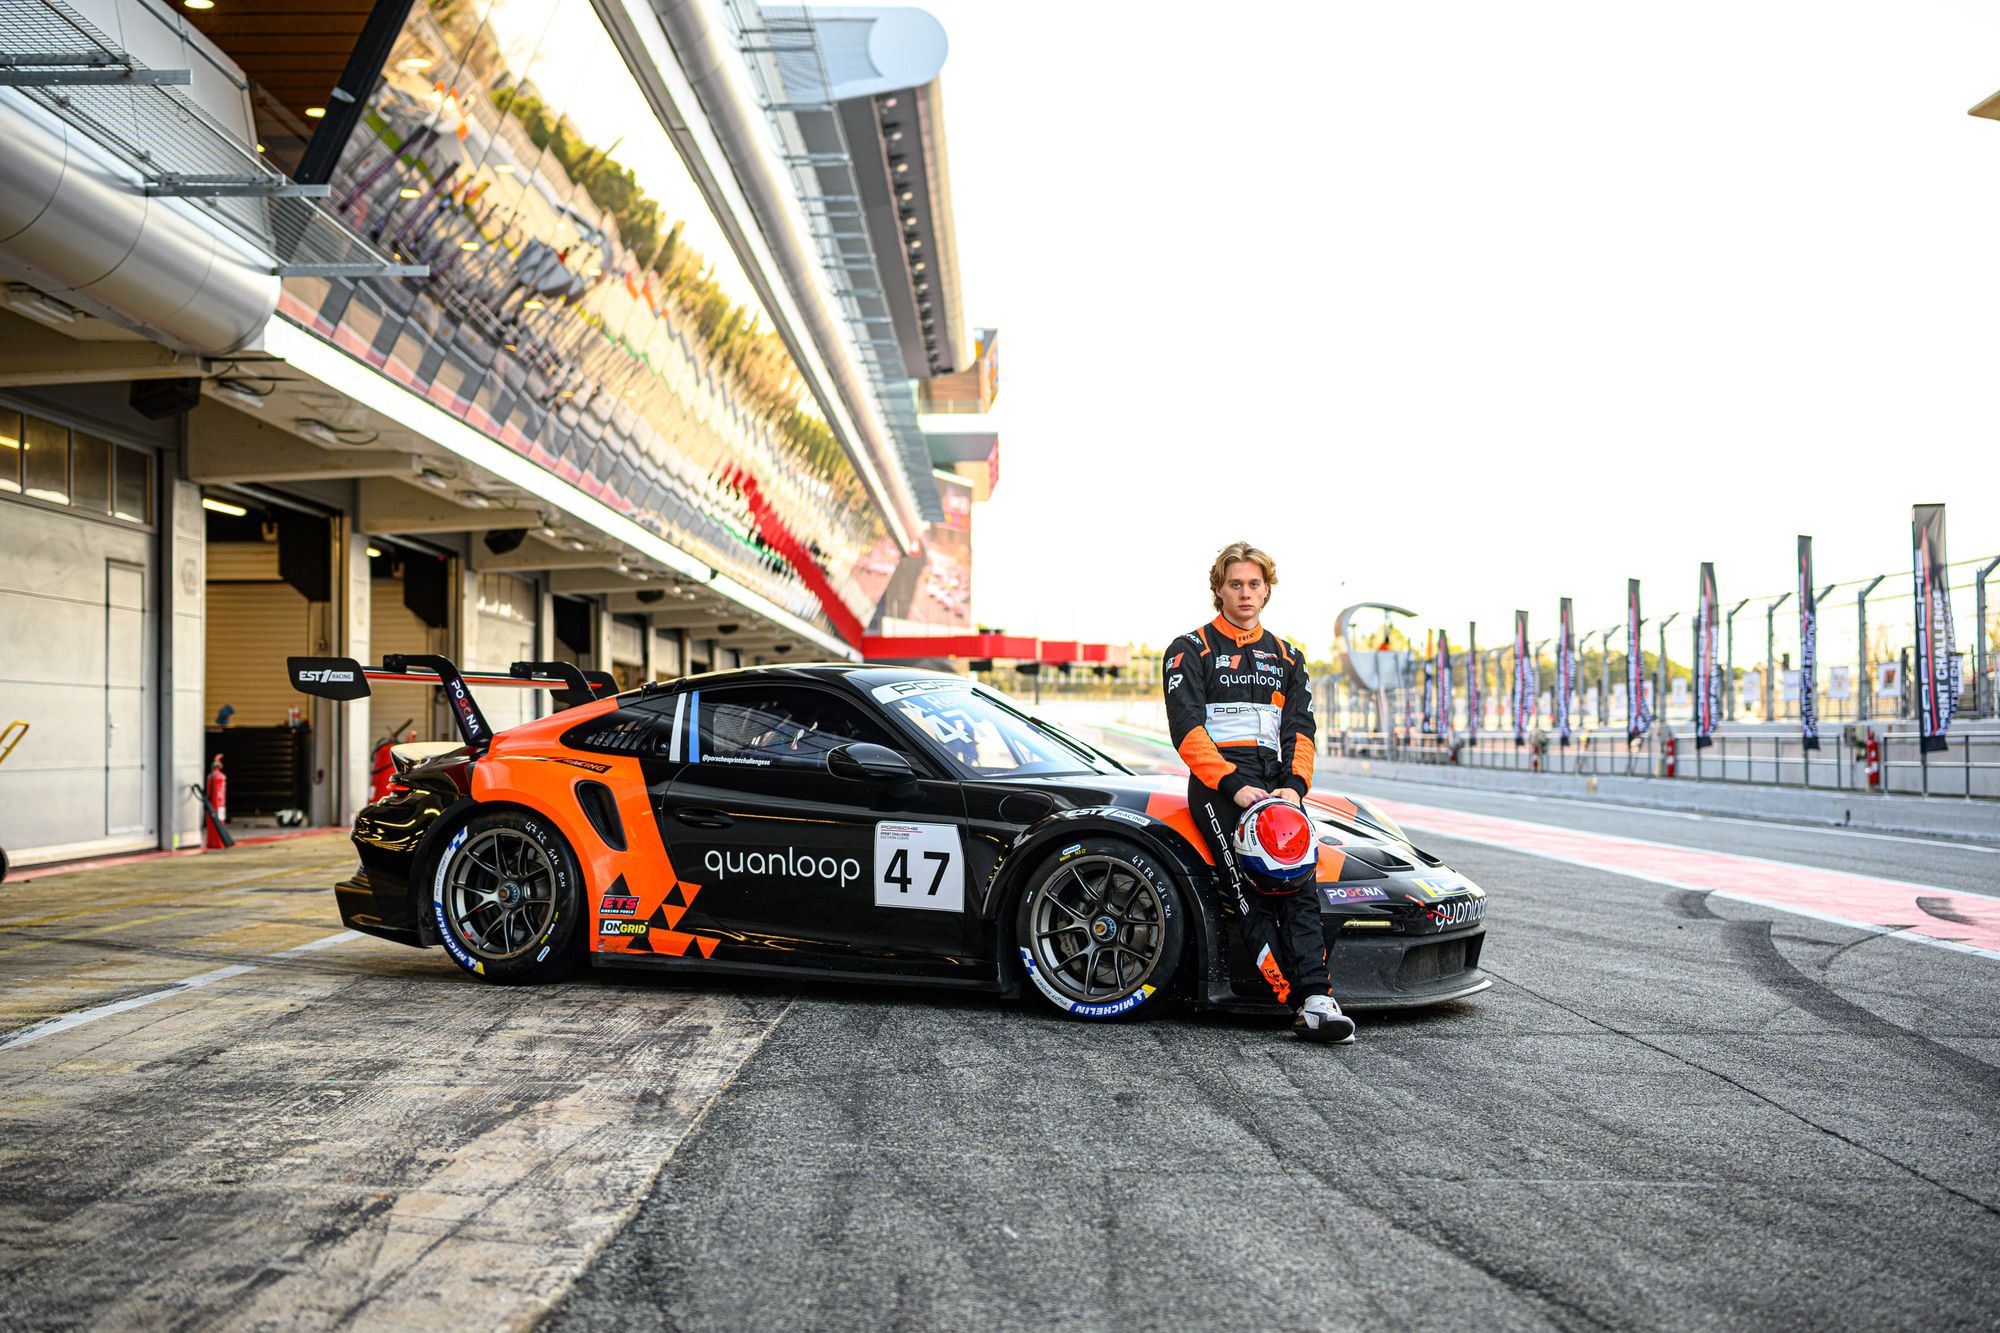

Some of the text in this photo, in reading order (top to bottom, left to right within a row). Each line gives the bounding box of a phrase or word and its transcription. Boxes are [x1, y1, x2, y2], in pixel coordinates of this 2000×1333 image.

[299, 669, 332, 683] EST1
[1219, 671, 1282, 691] quanloop
[919, 708, 985, 744] 47
[1116, 811, 1147, 825] RACING
[704, 846, 861, 888] quanloop
[883, 848, 951, 896] 47
[1132, 855, 1144, 868] 47
[1144, 867, 1154, 880] FR
[1204, 802, 1250, 915] PORSCHE
[603, 897, 638, 909] ETS
[435, 907, 467, 962] MICHELIN
[1036, 978, 1136, 1015] MICHELIN PILOT SPORT
